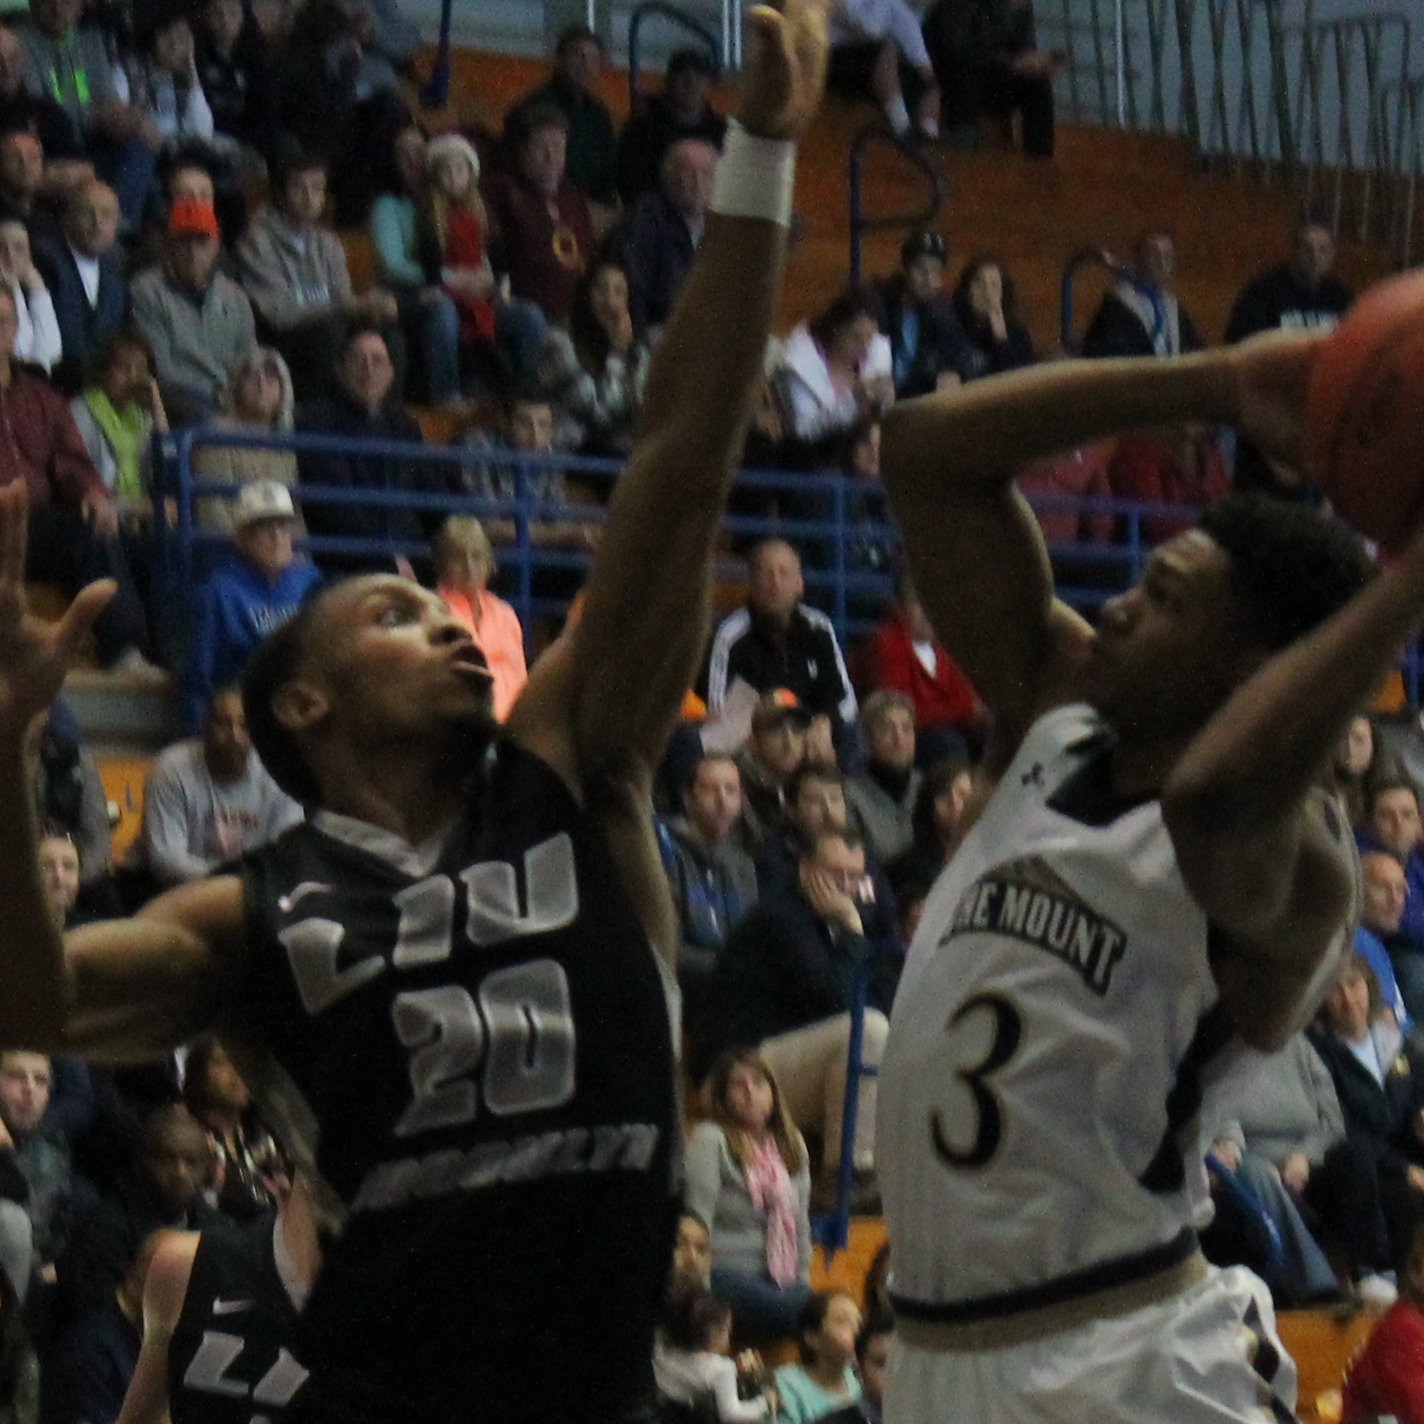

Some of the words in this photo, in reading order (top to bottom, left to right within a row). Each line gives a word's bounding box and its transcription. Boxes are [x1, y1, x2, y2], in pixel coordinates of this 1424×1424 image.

[278, 831, 579, 1017] LIU
[997, 885, 1120, 987] MOUNT
[390, 957, 576, 1138] 20
[929, 990, 1021, 1171] 3
[183, 1330, 311, 1408] LI
